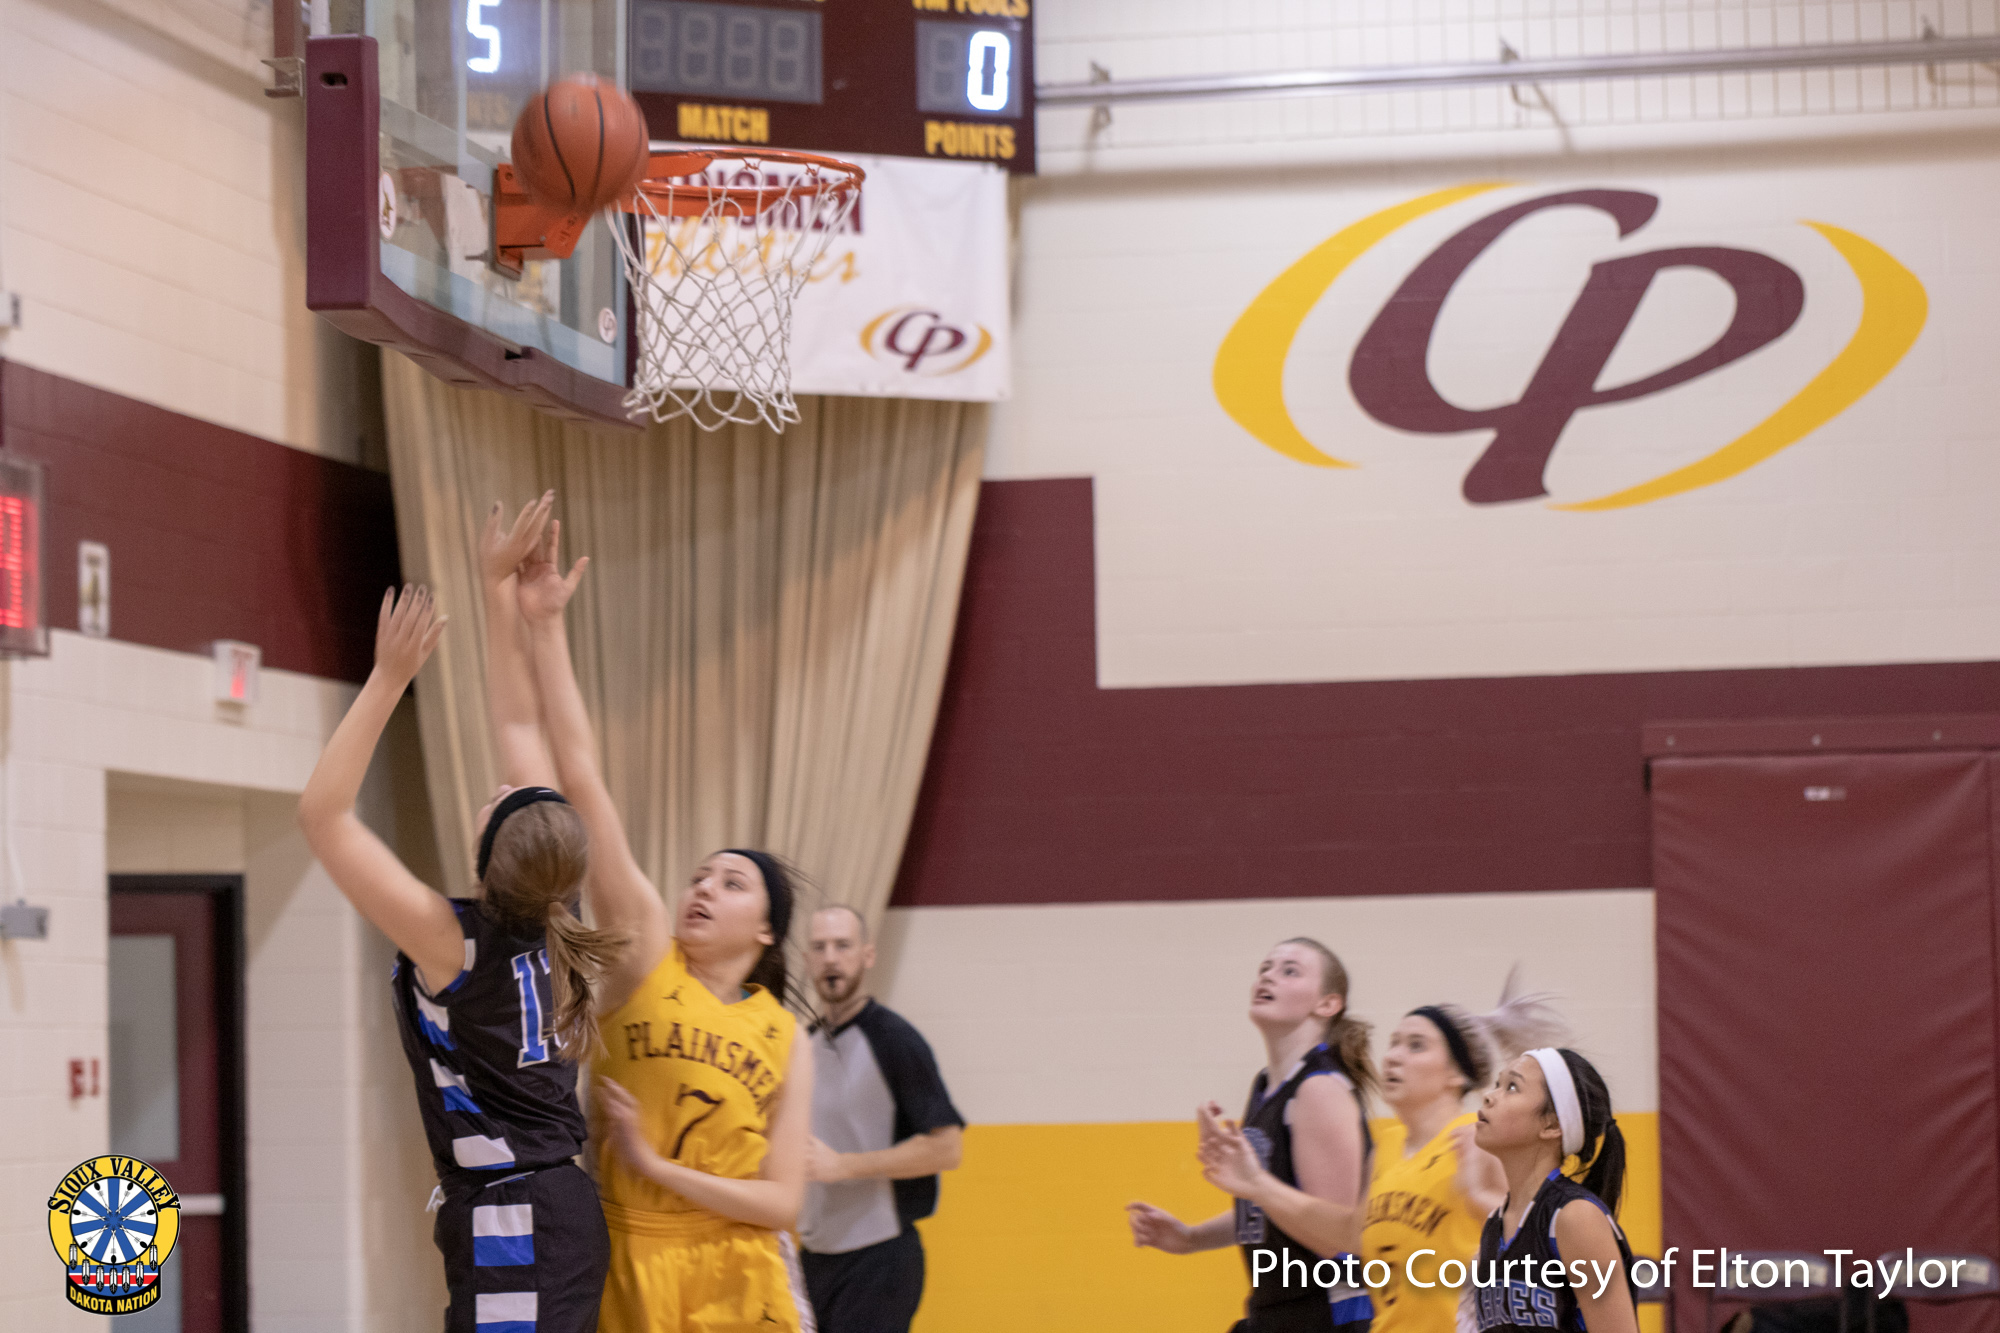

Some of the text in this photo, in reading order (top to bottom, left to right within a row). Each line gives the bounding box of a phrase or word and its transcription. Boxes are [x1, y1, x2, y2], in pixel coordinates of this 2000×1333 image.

[967, 31, 1010, 111] 0
[677, 103, 769, 143] MATCH
[924, 120, 1016, 159] POINTS
[671, 1083, 725, 1161] 7
